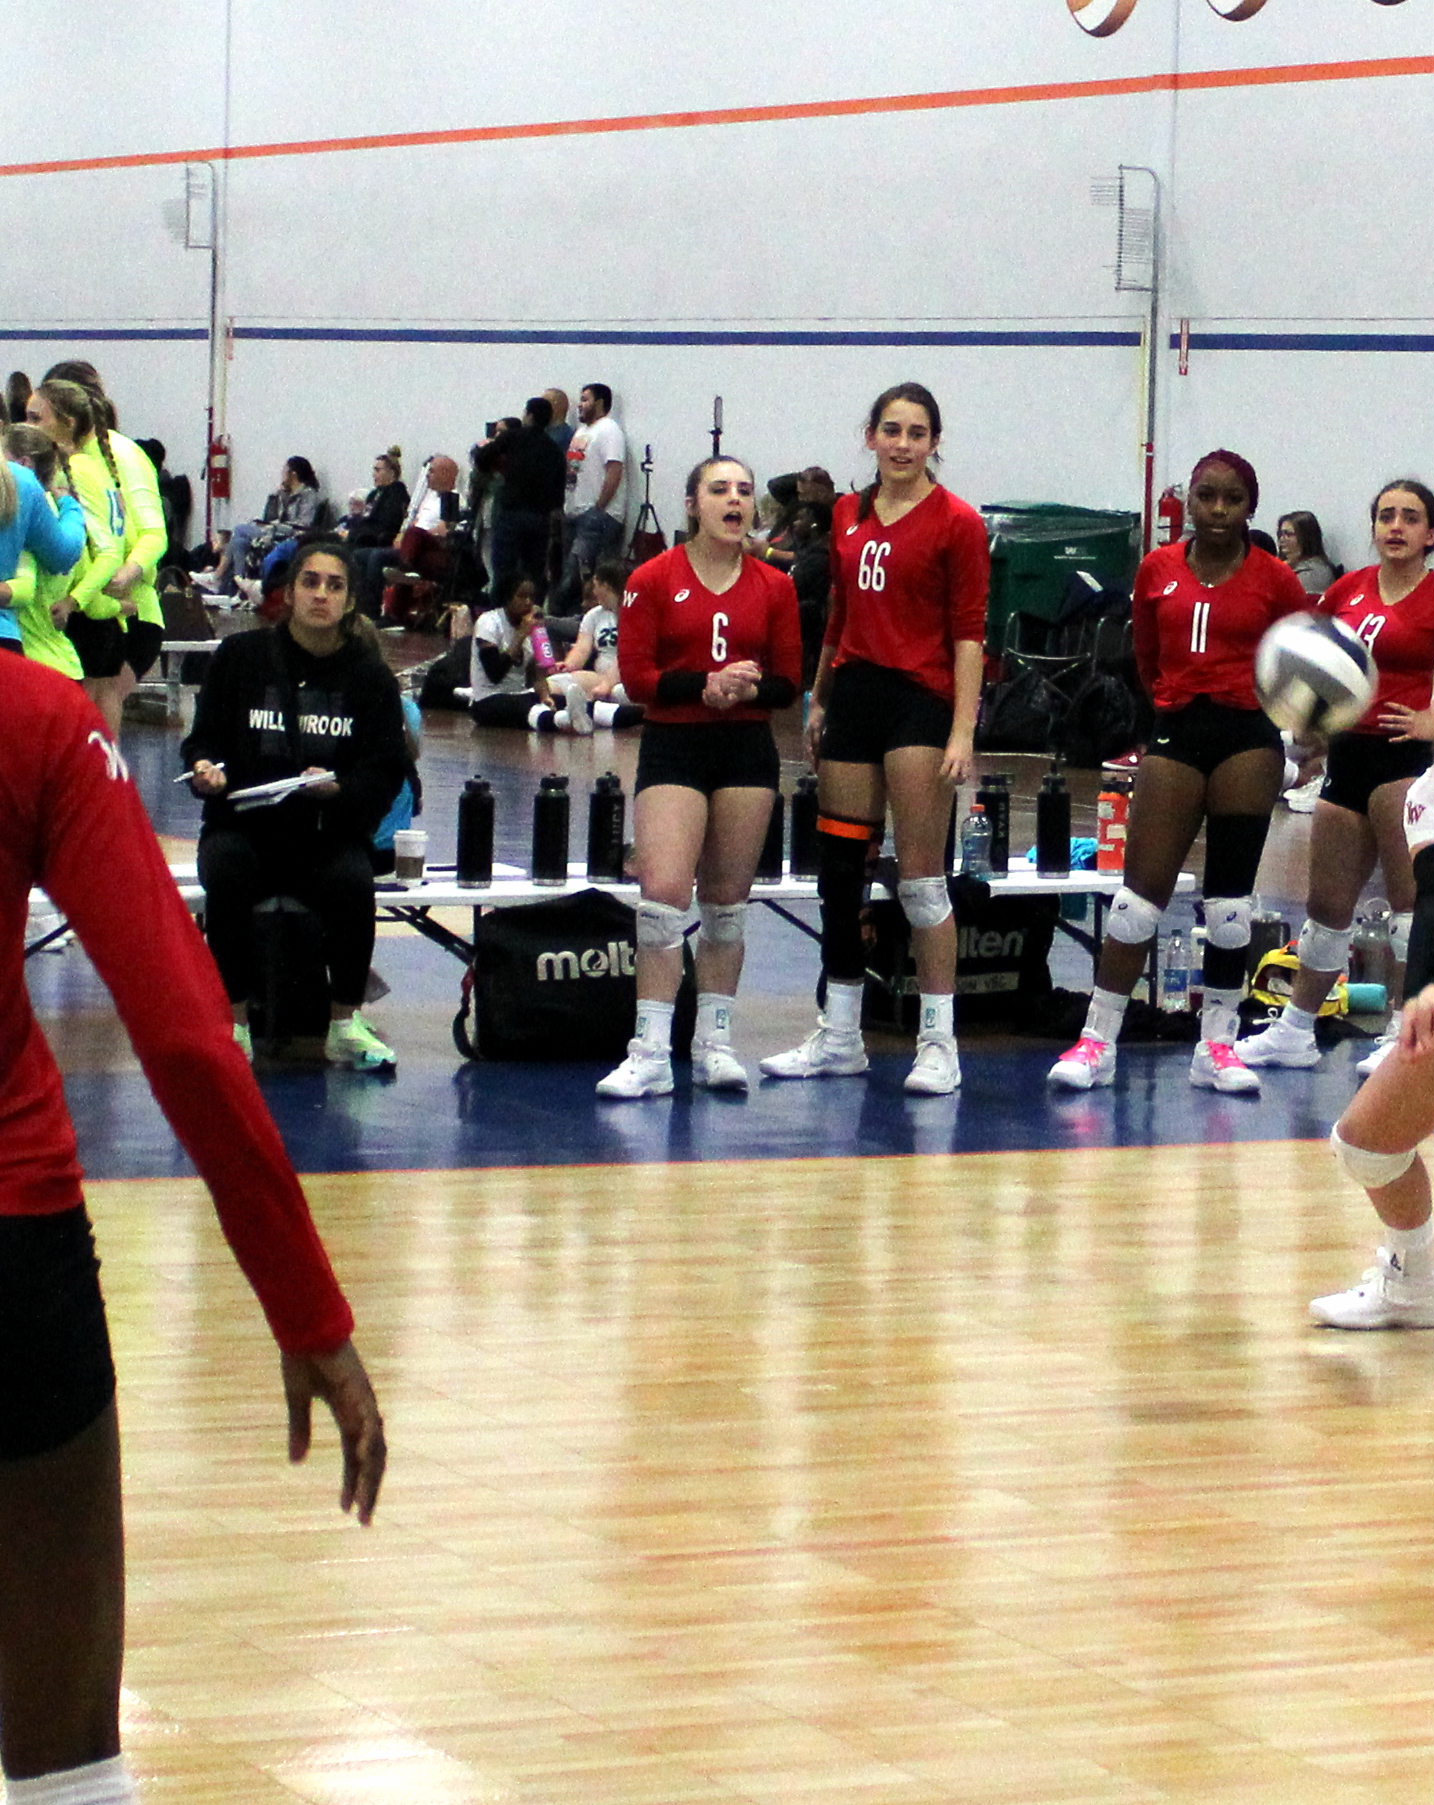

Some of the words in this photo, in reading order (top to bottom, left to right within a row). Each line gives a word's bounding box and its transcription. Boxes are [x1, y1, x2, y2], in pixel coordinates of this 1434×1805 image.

[858, 540, 891, 592] 66
[711, 611, 729, 662] 6
[1190, 602, 1210, 653] 11
[536, 940, 636, 981] molt
[908, 926, 1025, 959] lten
